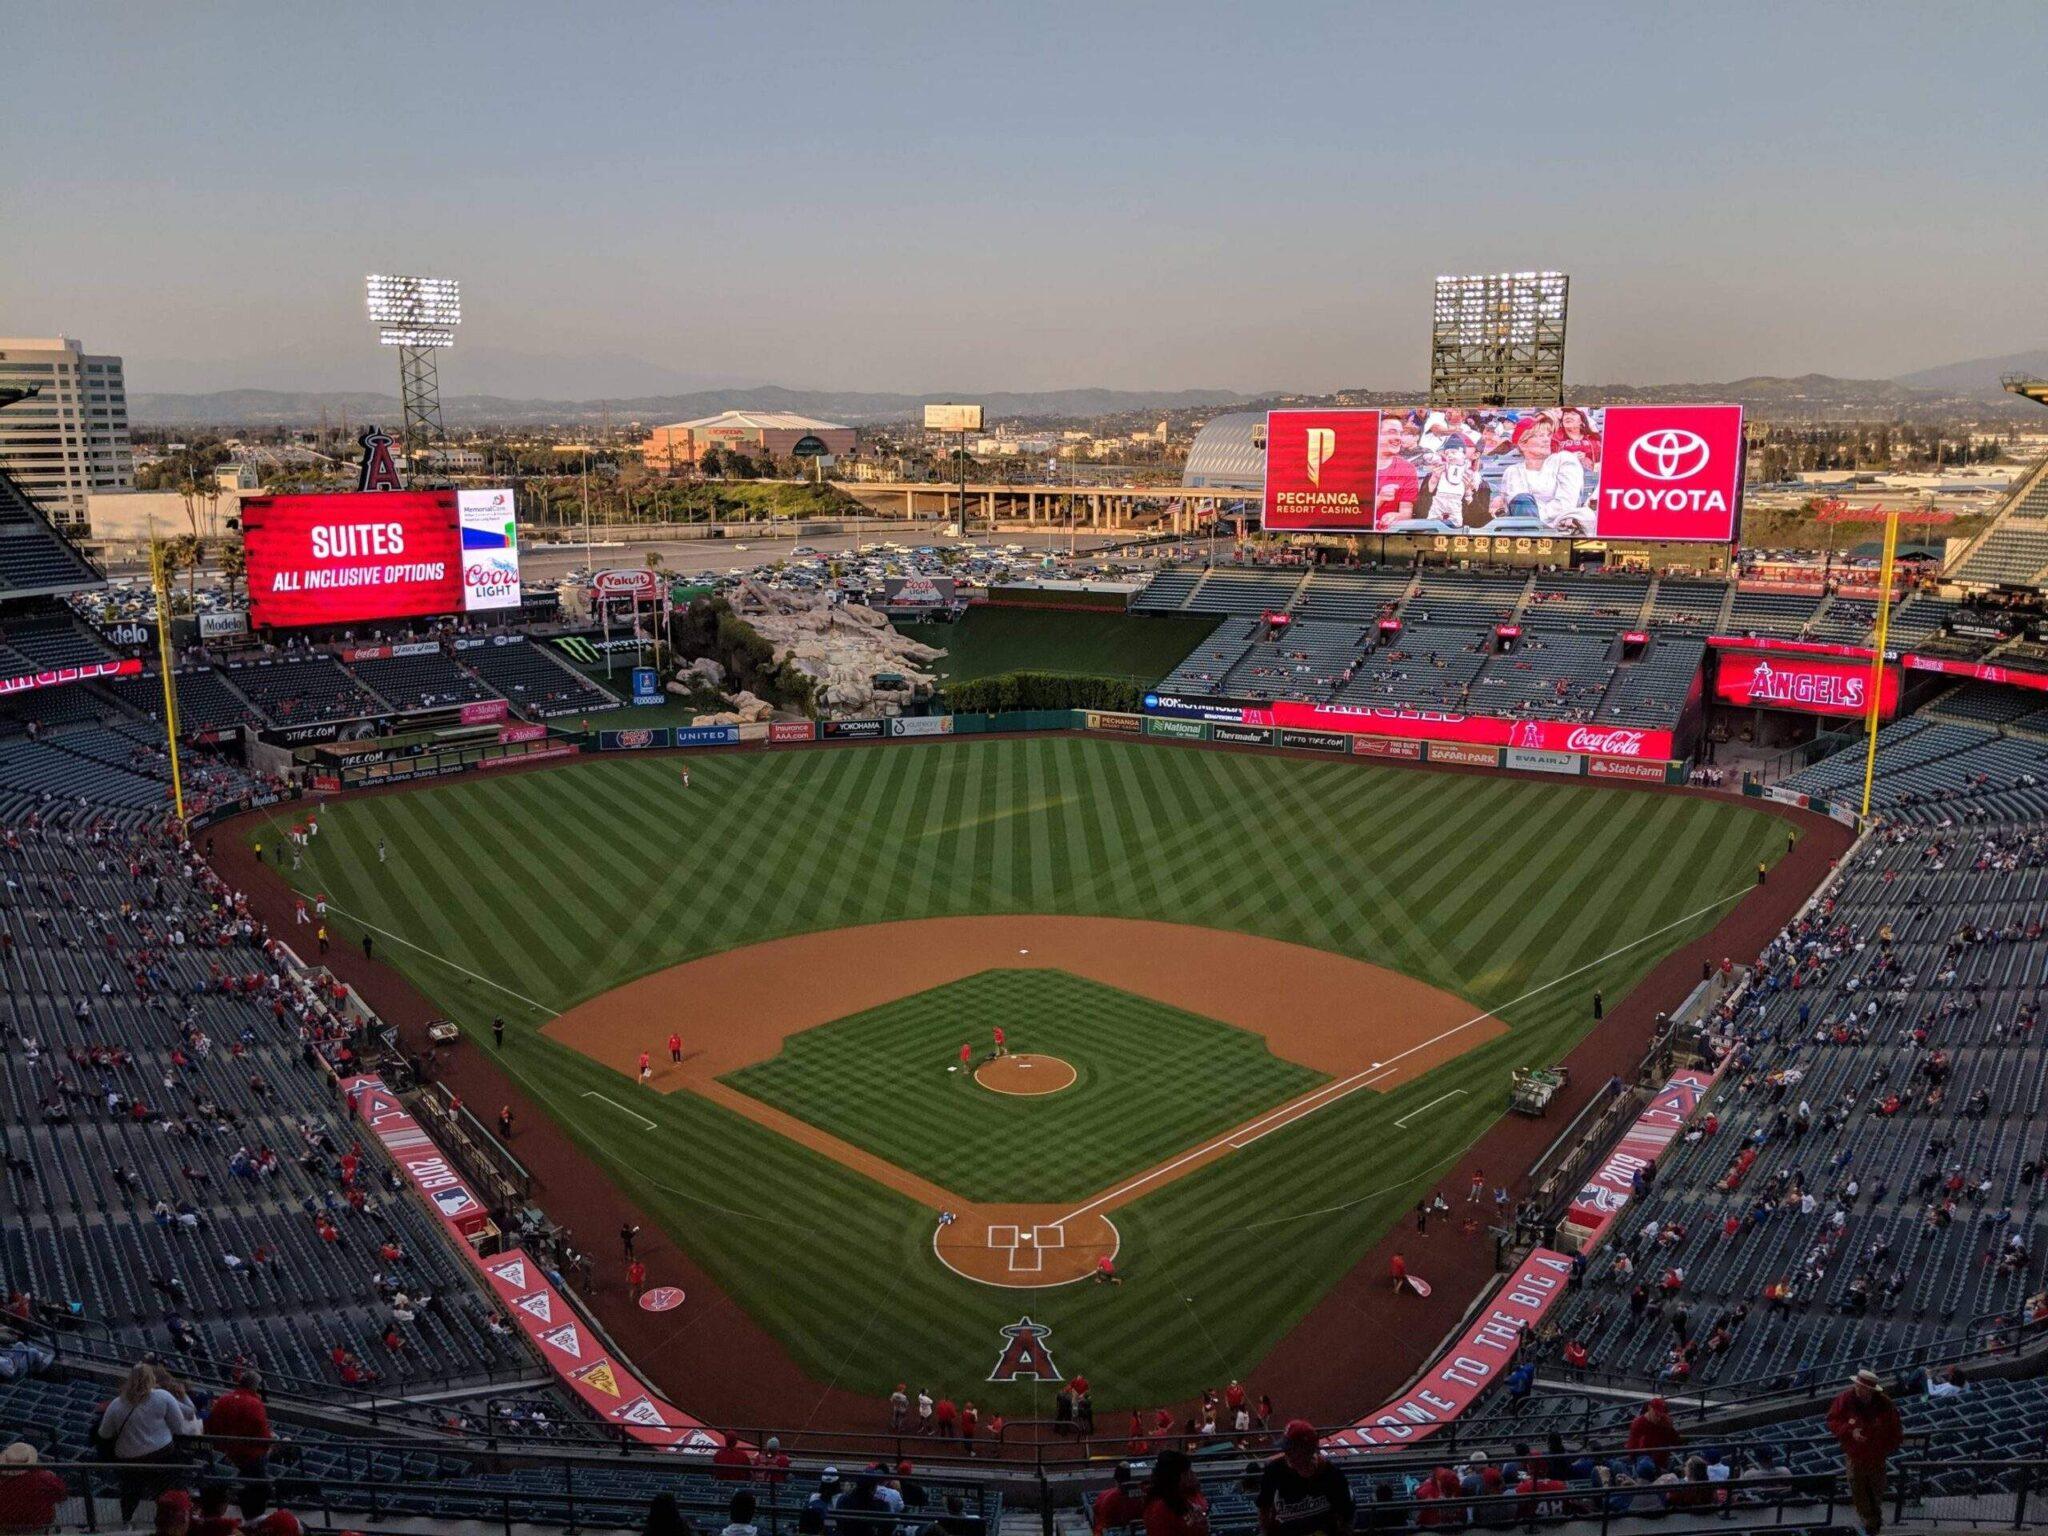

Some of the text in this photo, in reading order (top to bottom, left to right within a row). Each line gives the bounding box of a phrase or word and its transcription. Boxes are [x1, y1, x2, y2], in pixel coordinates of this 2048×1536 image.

[1276, 491, 1360, 505] PECHANGA
[1605, 487, 1727, 513] TOYOTA
[1276, 505, 1360, 515] RESORT CASINO
[311, 522, 405, 559] SUITES
[1518, 539, 1529, 547] 42
[272, 562, 445, 593] ALL INCLUSIVE OPTIONS
[463, 563, 519, 587] Coors
[605, 574, 647, 587] Yakult
[904, 577, 936, 590] Coors
[475, 585, 512, 598] LIGHT
[205, 616, 243, 631] Modelo
[1747, 661, 1864, 708] ANGELS
[775, 724, 809, 733] Insurance
[840, 721, 881, 731] YOKOHAMA
[1101, 718, 1140, 727] PECHANGA
[1163, 721, 1201, 733] National
[679, 732, 725, 741] UNITED
[775, 732, 809, 741] AAA.com
[1215, 729, 1262, 742] Thermador
[1284, 735, 1344, 747] NITTO TIRE.COM
[1431, 750, 1495, 764] SAFARI PARK
[1515, 755, 1557, 765] EVA AIR
[406, 1157, 459, 1189] 2019
[1599, 1153, 1648, 1188] 2019
[1441, 1356, 1490, 1388] TO
[1473, 1310, 1528, 1351] THE
[1508, 1272, 1557, 1310] BIG
[1535, 1257, 1571, 1273] A
[985, 1316, 1067, 1382] A
